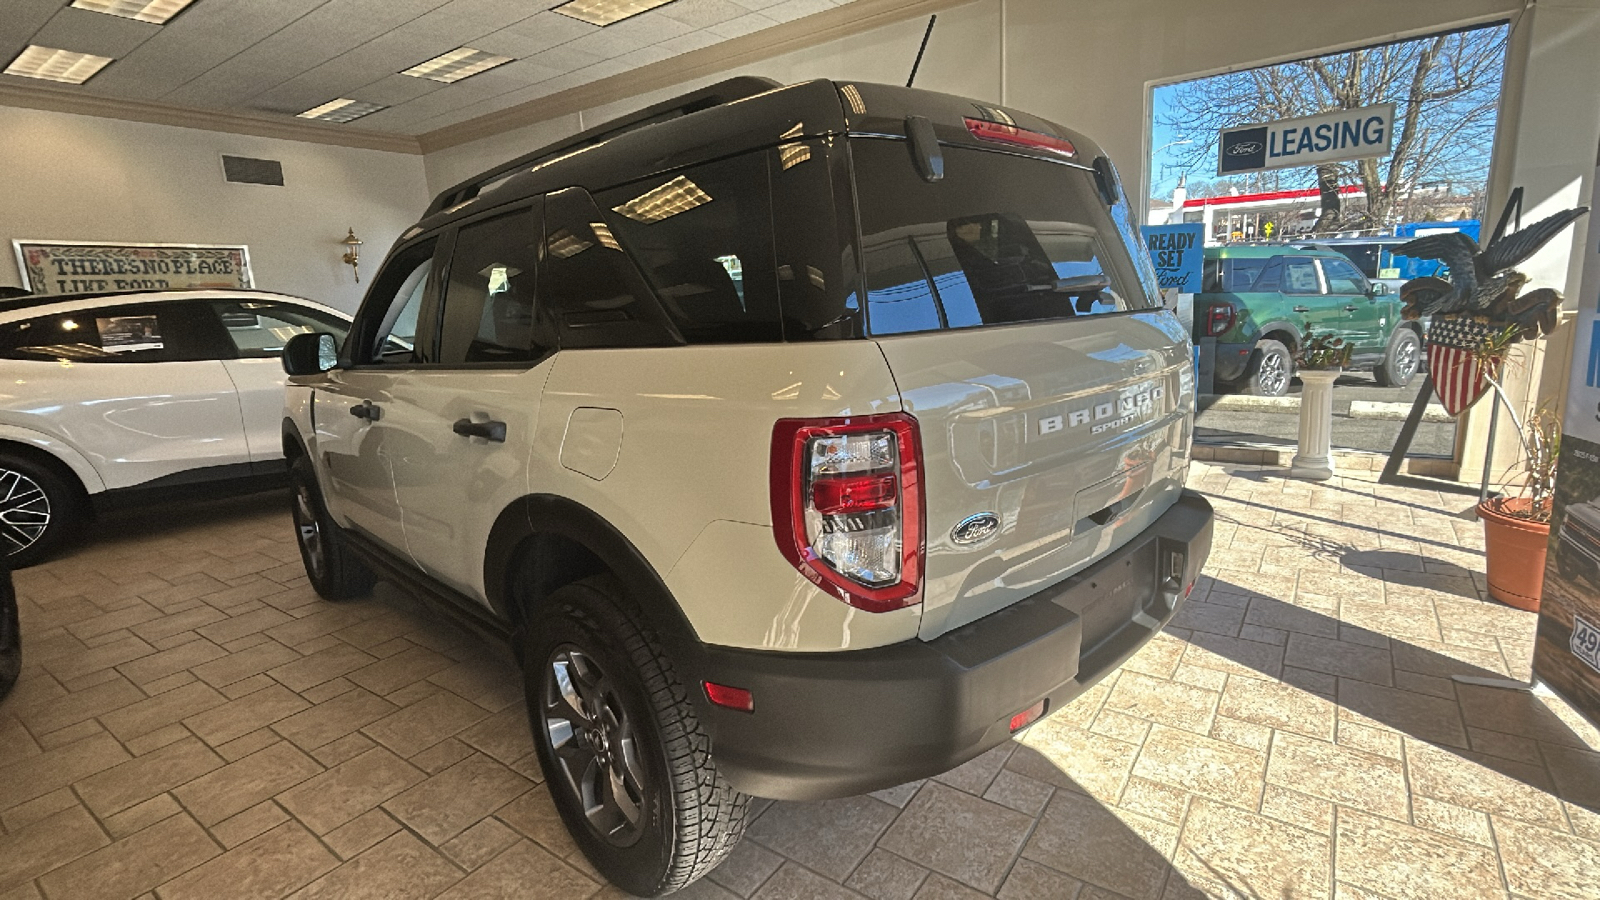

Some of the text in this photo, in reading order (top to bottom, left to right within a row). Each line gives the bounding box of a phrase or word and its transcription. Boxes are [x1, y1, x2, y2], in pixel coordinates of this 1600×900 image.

[1232, 116, 1384, 158] Ford LEASING
[1149, 232, 1196, 250] READY
[172, 259, 233, 275] PLACE
[1157, 250, 1185, 268] SET
[1155, 267, 1193, 287] Ford
[1038, 386, 1165, 436] BRONCO
[1090, 413, 1137, 436] SPORT
[964, 519, 994, 539] Ford
[1576, 627, 1597, 652] 49
